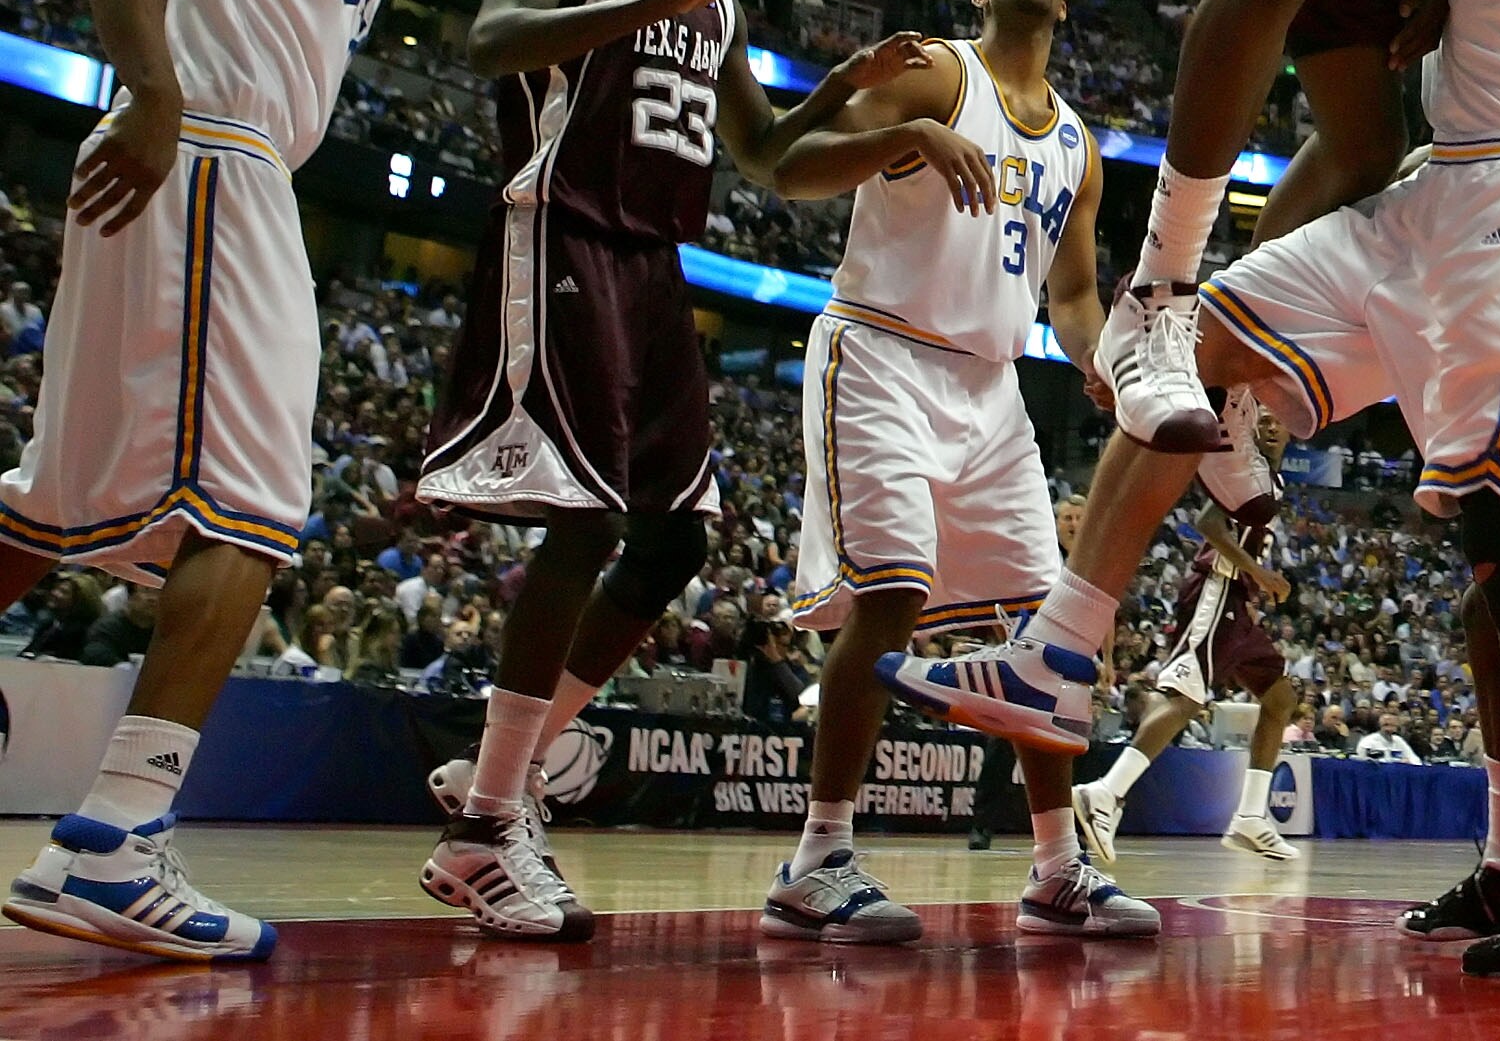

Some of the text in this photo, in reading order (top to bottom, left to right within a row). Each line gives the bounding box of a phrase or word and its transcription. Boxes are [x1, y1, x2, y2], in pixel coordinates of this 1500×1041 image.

[633, 19, 720, 80] TEXS A&M
[631, 65, 718, 167] 23
[1002, 220, 1028, 276] 3
[719, 734, 804, 778] FIRST
[875, 739, 966, 782] SECOND
[714, 781, 755, 812] BIG
